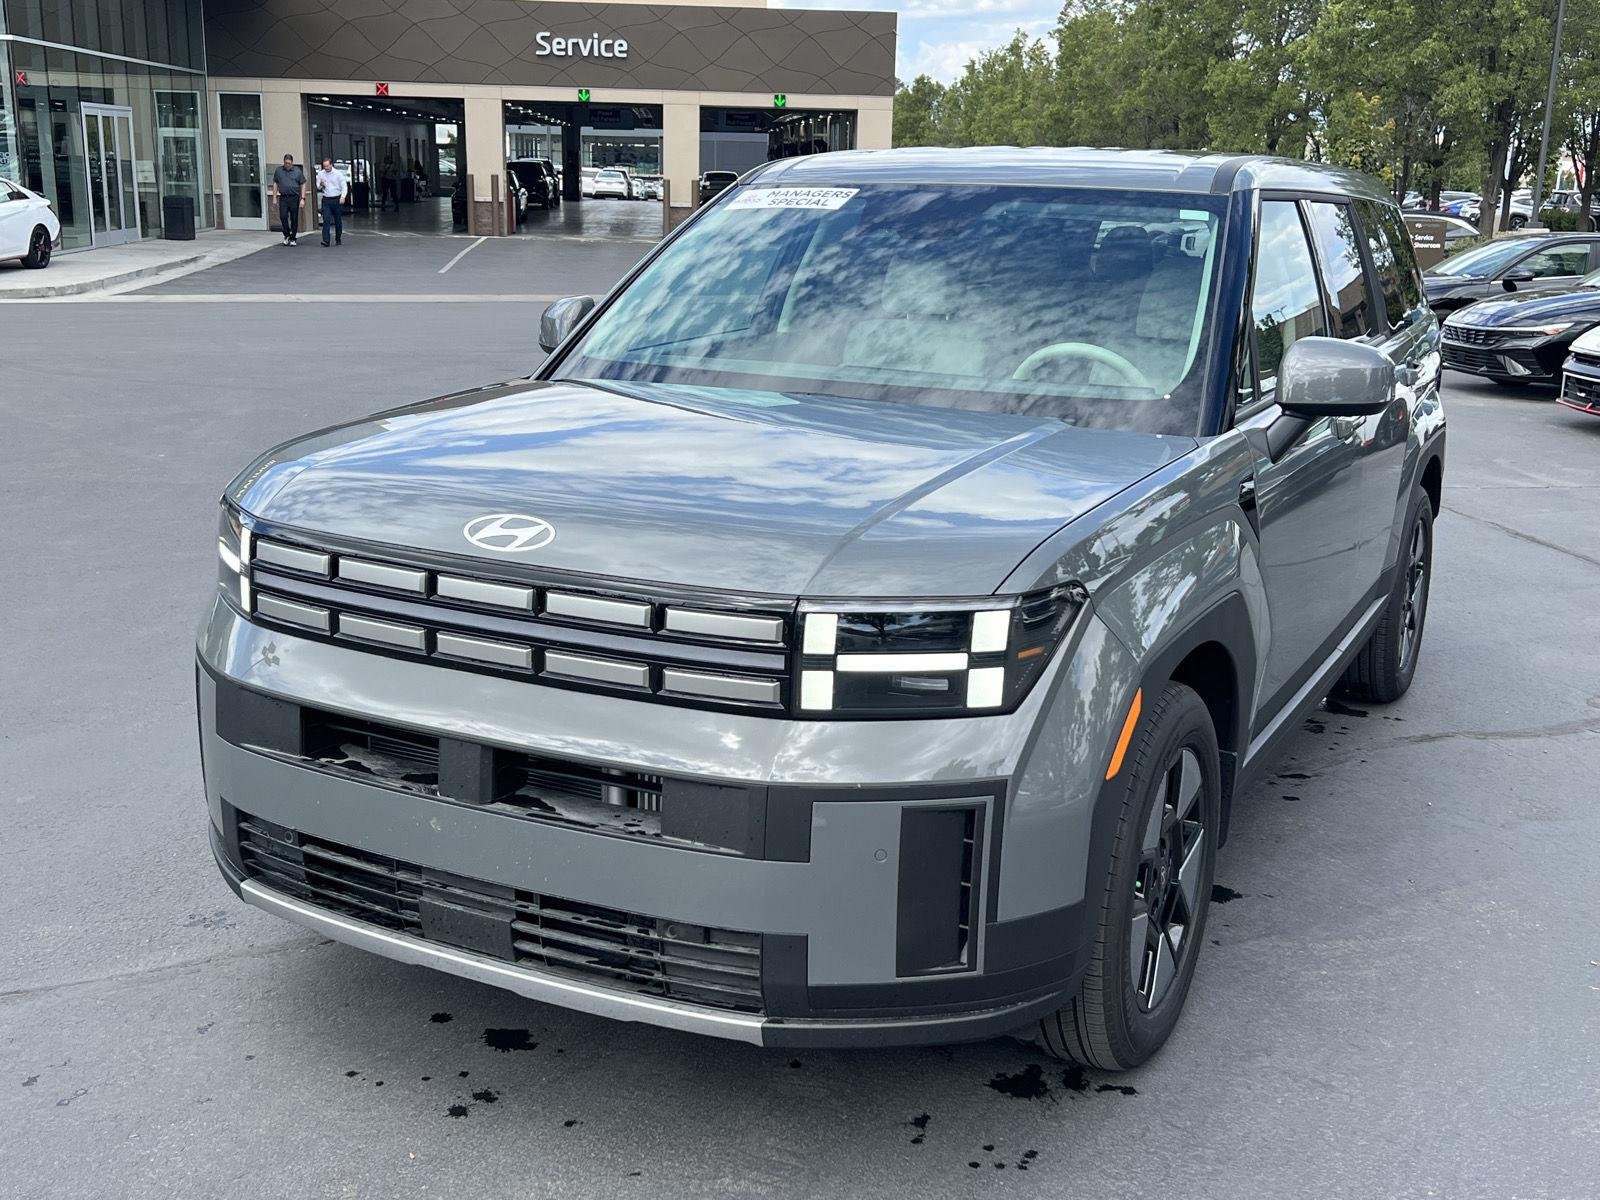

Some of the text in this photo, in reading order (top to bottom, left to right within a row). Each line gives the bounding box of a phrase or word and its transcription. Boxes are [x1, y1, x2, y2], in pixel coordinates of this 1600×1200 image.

[535, 31, 628, 58] Service
[767, 190, 853, 199] MANAGERS
[767, 198, 829, 207] SPECIAL
